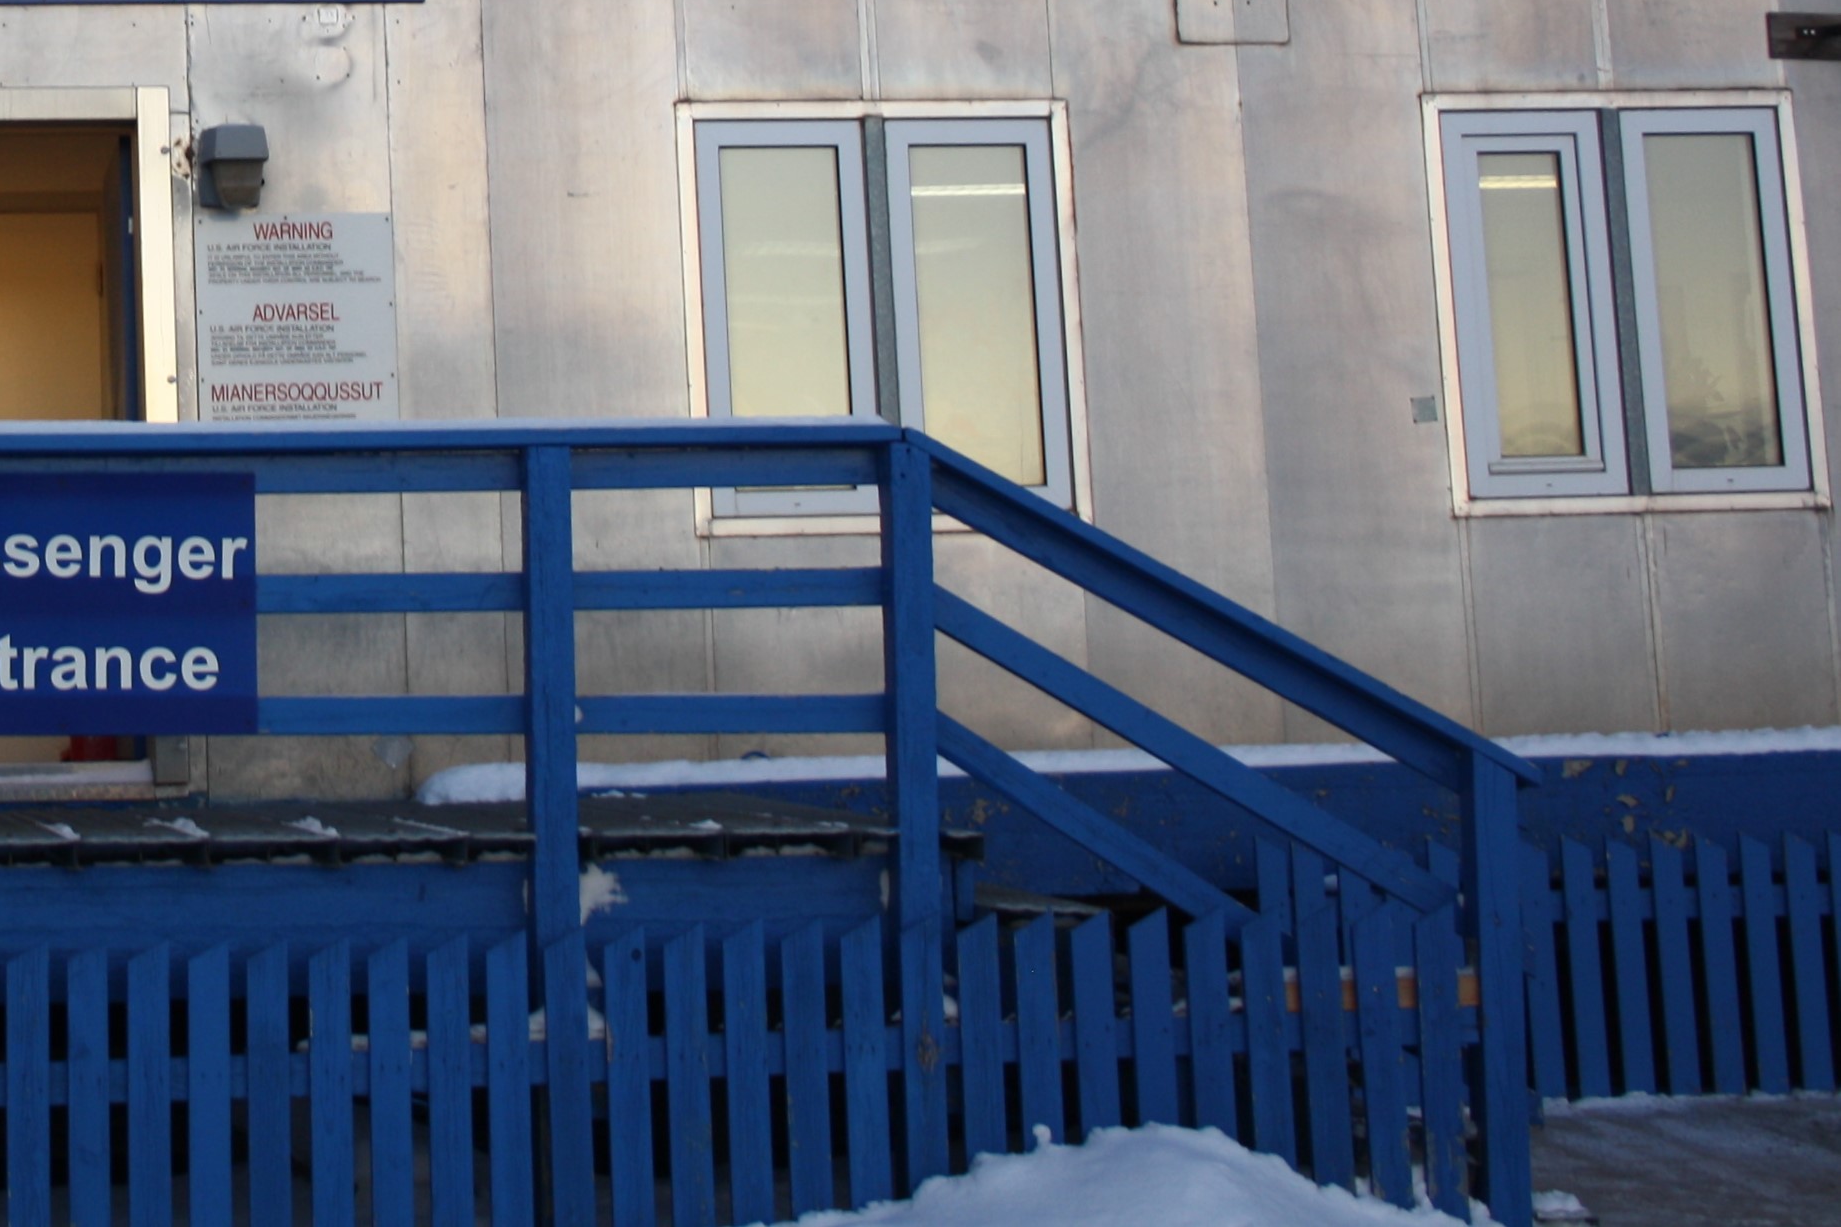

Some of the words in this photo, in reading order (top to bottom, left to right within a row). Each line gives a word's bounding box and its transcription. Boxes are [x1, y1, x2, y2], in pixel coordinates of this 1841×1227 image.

[253, 221, 333, 240] WARNING
[253, 302, 340, 322] ADVARSEL
[211, 382, 383, 402] MIANERSOQQUSSUT
